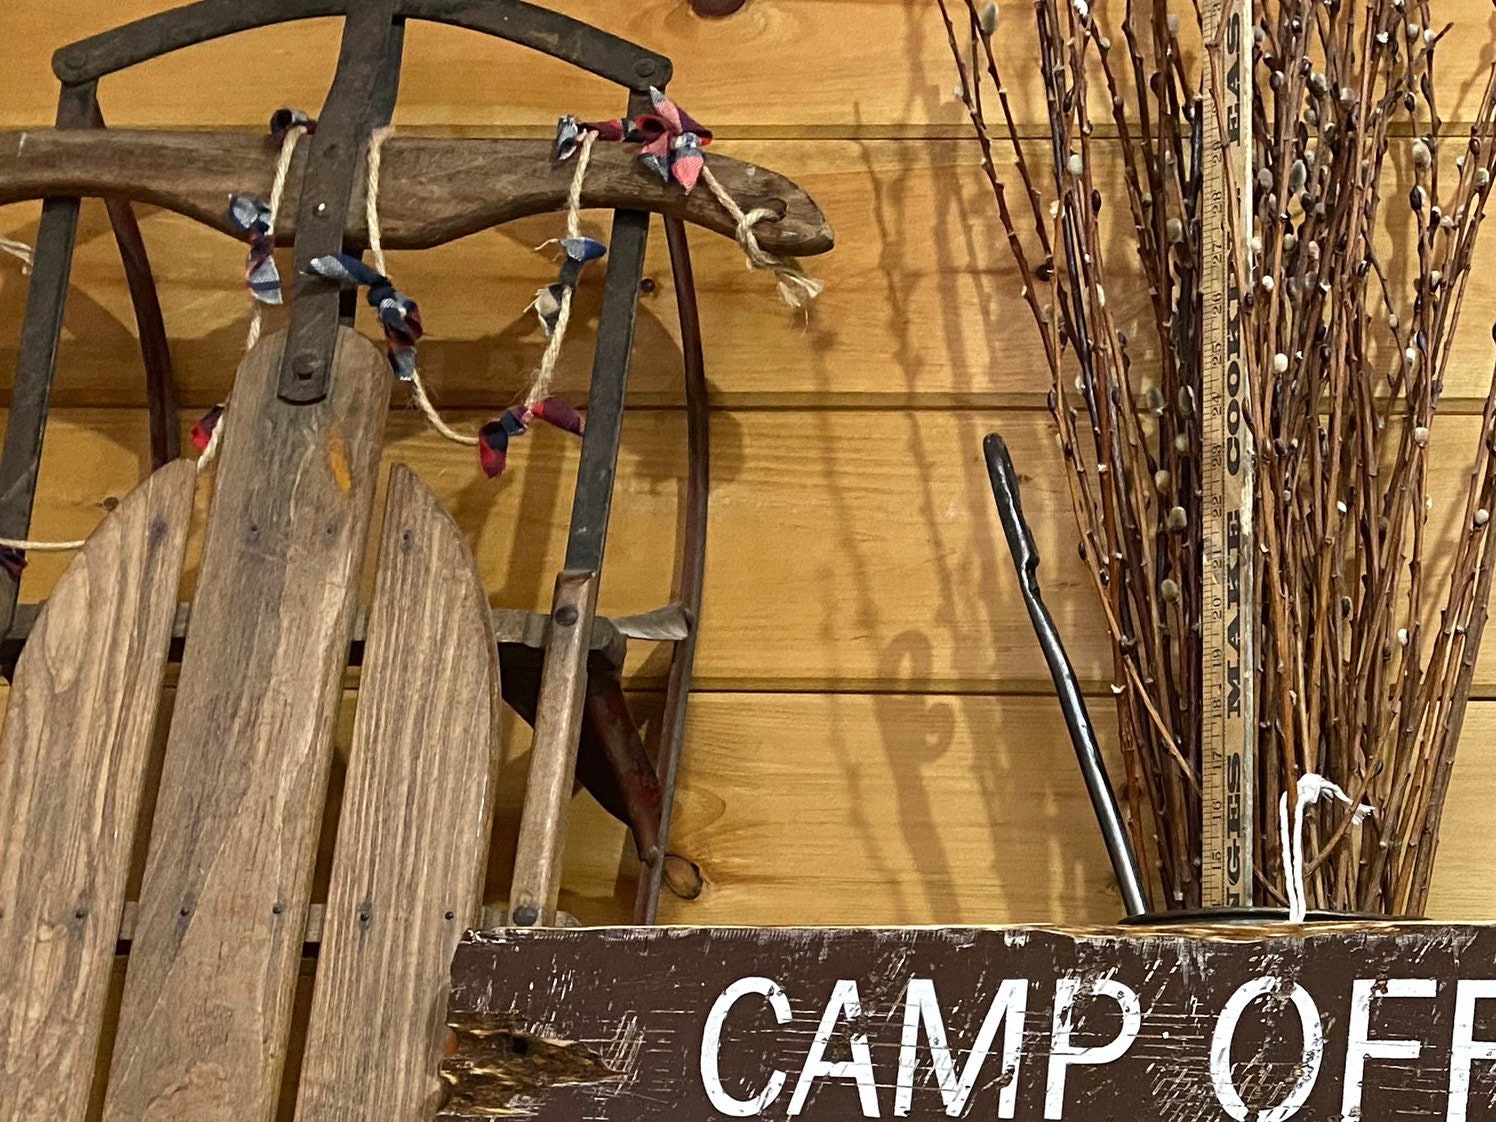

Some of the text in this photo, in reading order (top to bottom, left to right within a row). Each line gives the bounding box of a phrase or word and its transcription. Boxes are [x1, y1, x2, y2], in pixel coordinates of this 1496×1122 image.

[1211, 191, 1222, 214] 28
[1211, 243, 1222, 264] 27
[1211, 293, 1222, 315] 26
[1226, 181, 1241, 476] COOKI
[1211, 343, 1222, 366] 25
[1211, 393, 1222, 416] 24
[1211, 444, 1222, 467] 23
[1211, 496, 1222, 517] 22
[1211, 549, 1222, 569] 21
[1211, 597, 1222, 620] 20
[1226, 510, 1241, 718] MAKE
[1211, 648, 1222, 668] 19
[1211, 699, 1222, 719] 18
[1211, 751, 1222, 770] 17
[1211, 801, 1222, 820] 16
[1211, 852, 1222, 870] 15
[700, 977, 1142, 1121] CAMP
